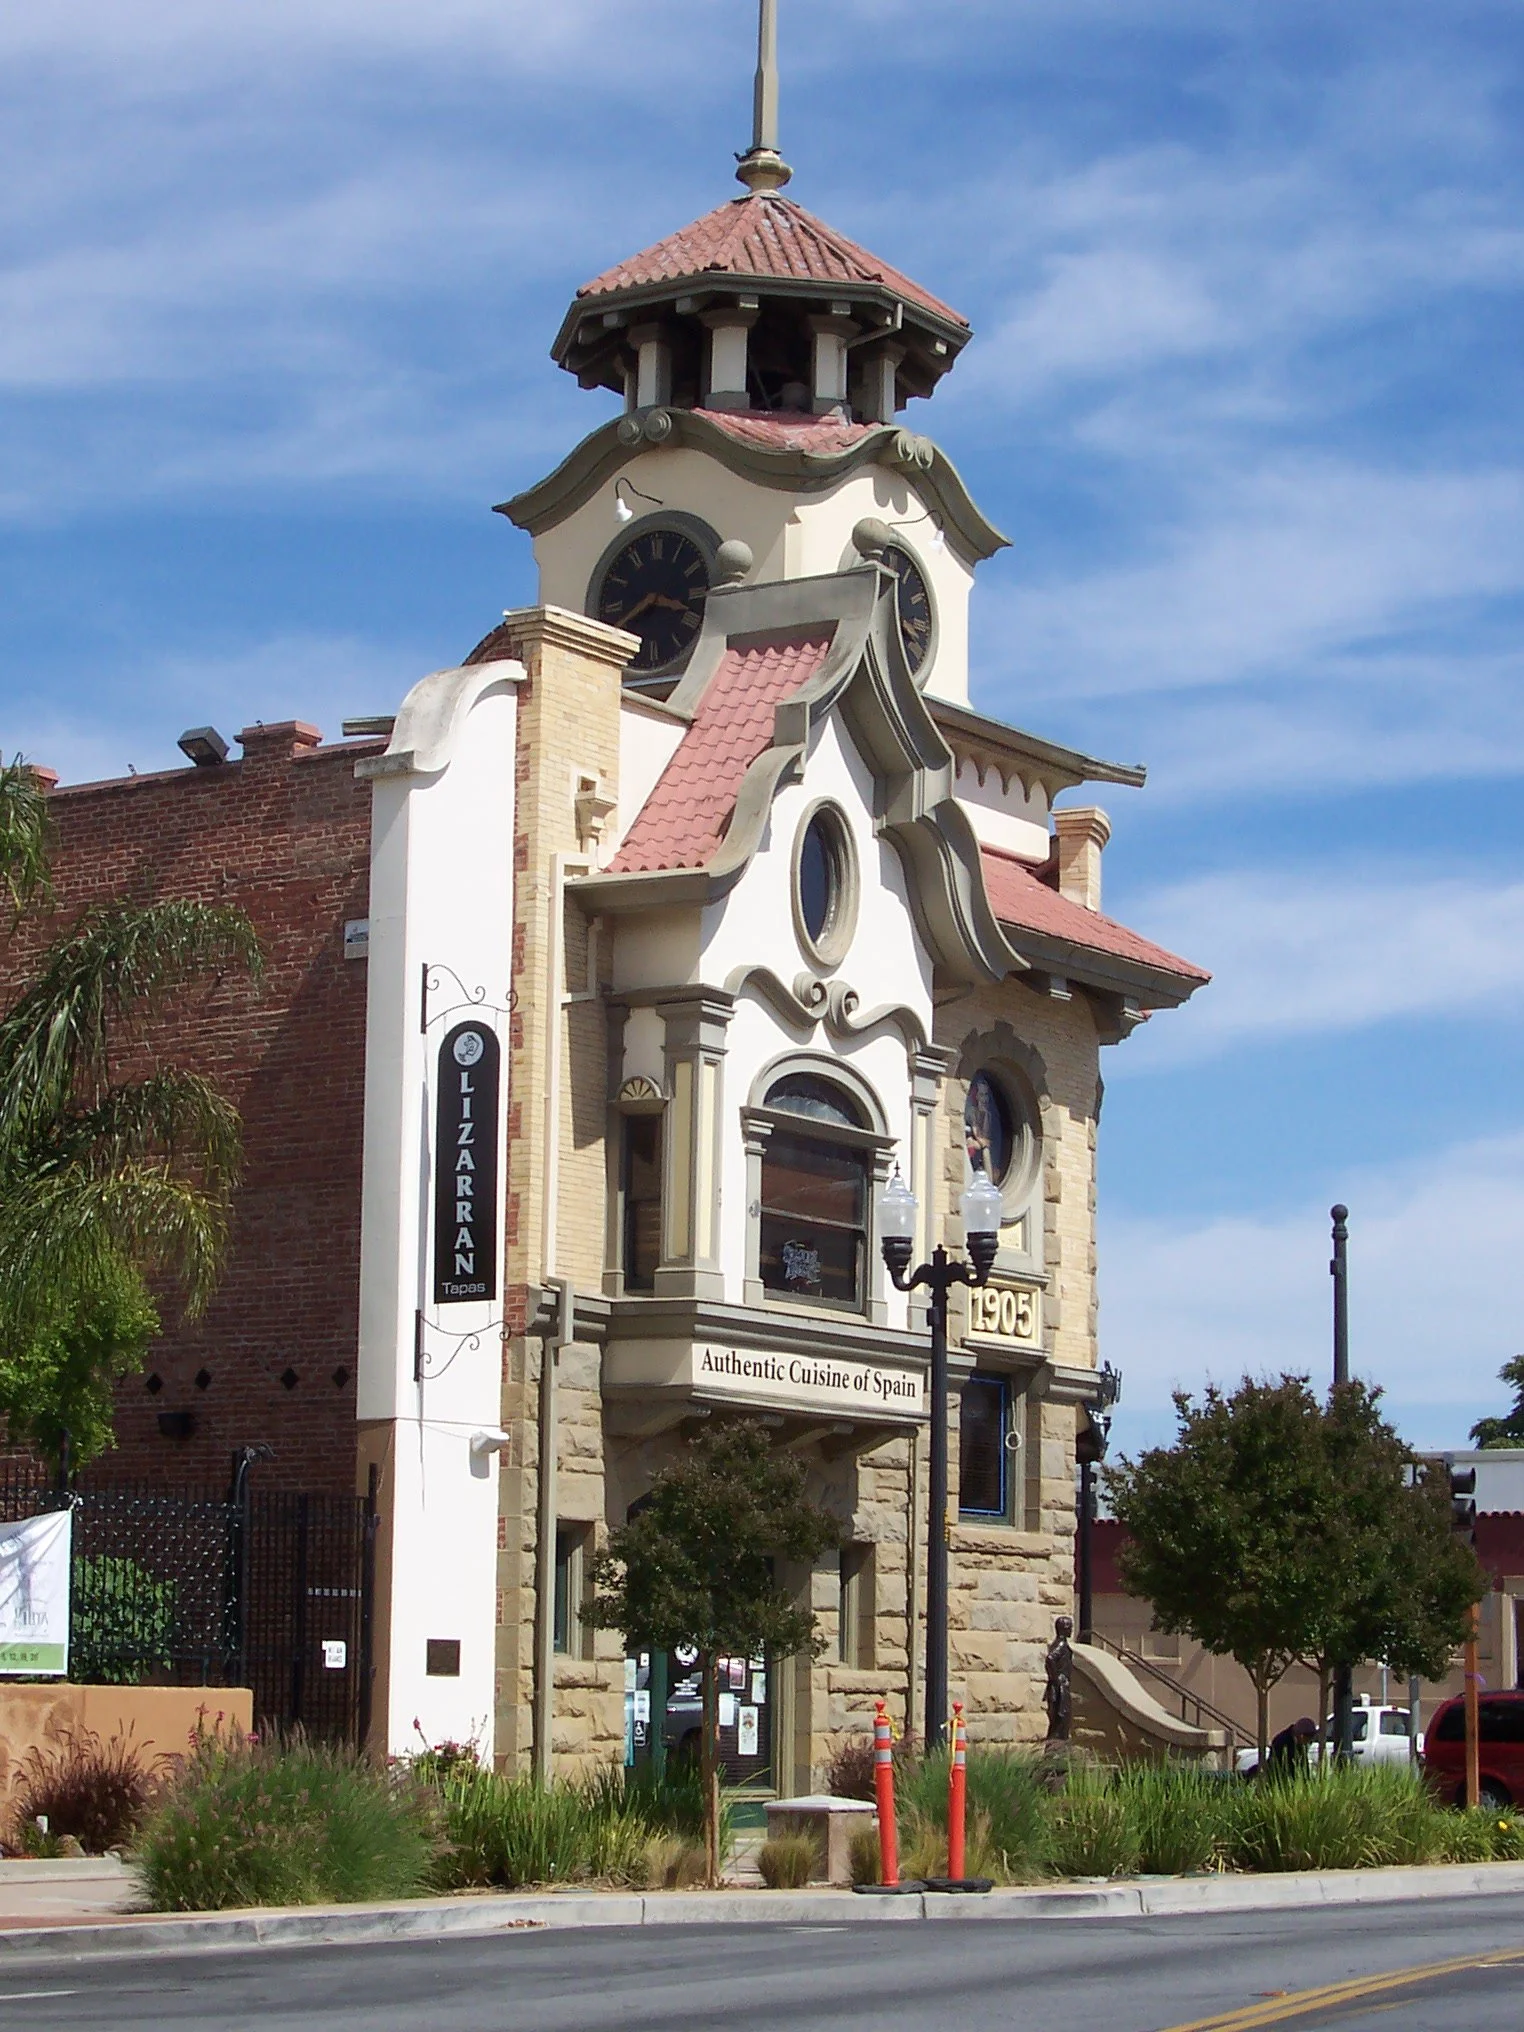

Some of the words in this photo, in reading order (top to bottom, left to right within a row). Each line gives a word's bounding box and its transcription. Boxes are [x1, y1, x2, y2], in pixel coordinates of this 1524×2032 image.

[454, 1071, 476, 1276] LIZARRAN
[441, 1282, 486, 1296] Tapas
[972, 1286, 1032, 1337] 1905
[701, 1348, 785, 1381] Authentic
[789, 1360, 850, 1389] Cuisine
[854, 1368, 871, 1391] of
[873, 1371, 916, 1400] Spain
